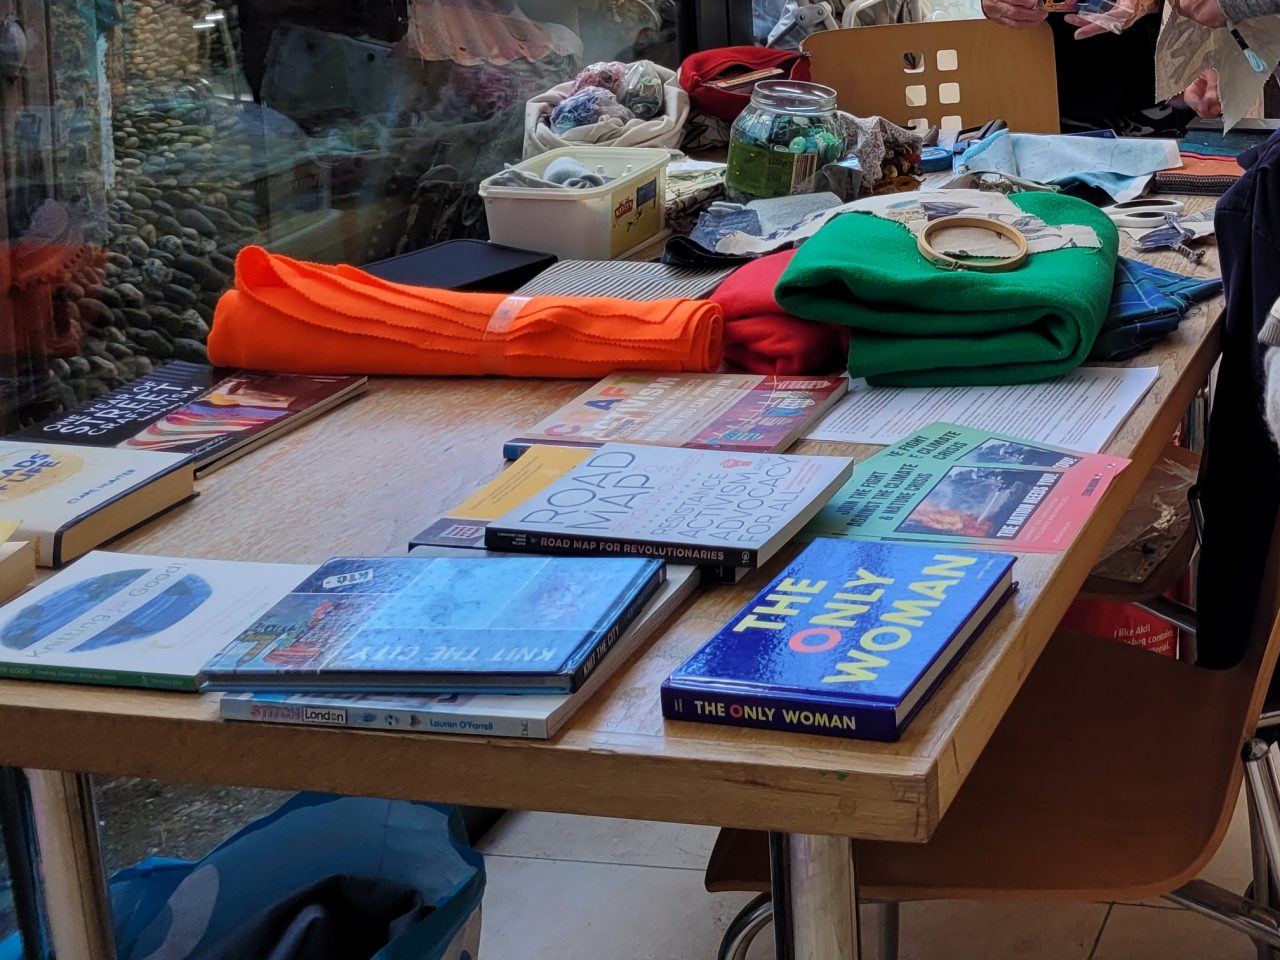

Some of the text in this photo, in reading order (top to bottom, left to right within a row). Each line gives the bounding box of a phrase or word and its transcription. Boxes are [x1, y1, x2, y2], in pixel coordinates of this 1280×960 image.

[43, 414, 86, 432] ONE
[83, 393, 133, 413] YEAR
[133, 381, 157, 393] OF
[60, 382, 183, 434] STREET
[88, 385, 205, 436] CRAFTIVISM
[0, 453, 50, 480] ADS
[898, 435, 931, 452] FIGHT
[917, 430, 962, 456] CLIMATE
[932, 441, 969, 461] CRISIS
[1051, 456, 1077, 468] OU!
[6, 461, 61, 482] LIFE
[520, 451, 636, 524] ROAD
[835, 471, 889, 515] JOIN THE FIGHT
[846, 463, 919, 527] AGAINST THE CLIMATE
[884, 491, 916, 515] NATURE
[904, 473, 934, 492] CRISIS
[565, 473, 654, 530] MAP
[651, 472, 728, 535] RESISTANCE
[678, 472, 758, 539] ACTIVISM
[708, 456, 797, 540] ADVOCACY
[737, 487, 806, 541] FOR ALL
[1005, 503, 1035, 525] NATION
[540, 537, 570, 549] ROAD
[573, 540, 597, 551] MAP
[600, 541, 621, 553] FOR
[624, 543, 724, 561] REVOLUTIONARIES
[996, 525, 1019, 537] THE
[24, 613, 111, 659] Knitting
[128, 562, 187, 596] Good!
[733, 577, 828, 633] THE
[788, 567, 896, 653] ONLY
[821, 554, 978, 683] WOMAN
[347, 645, 558, 662] KNIT THE CITY
[583, 622, 619, 677] KNIT THE CITY
[1118, 627, 1134, 637] like
[429, 719, 458, 730] Lauren
[460, 720, 494, 732] O'Farrell
[694, 700, 725, 717] THE
[730, 704, 775, 722] ONLY
[782, 709, 856, 730] WOMAN
